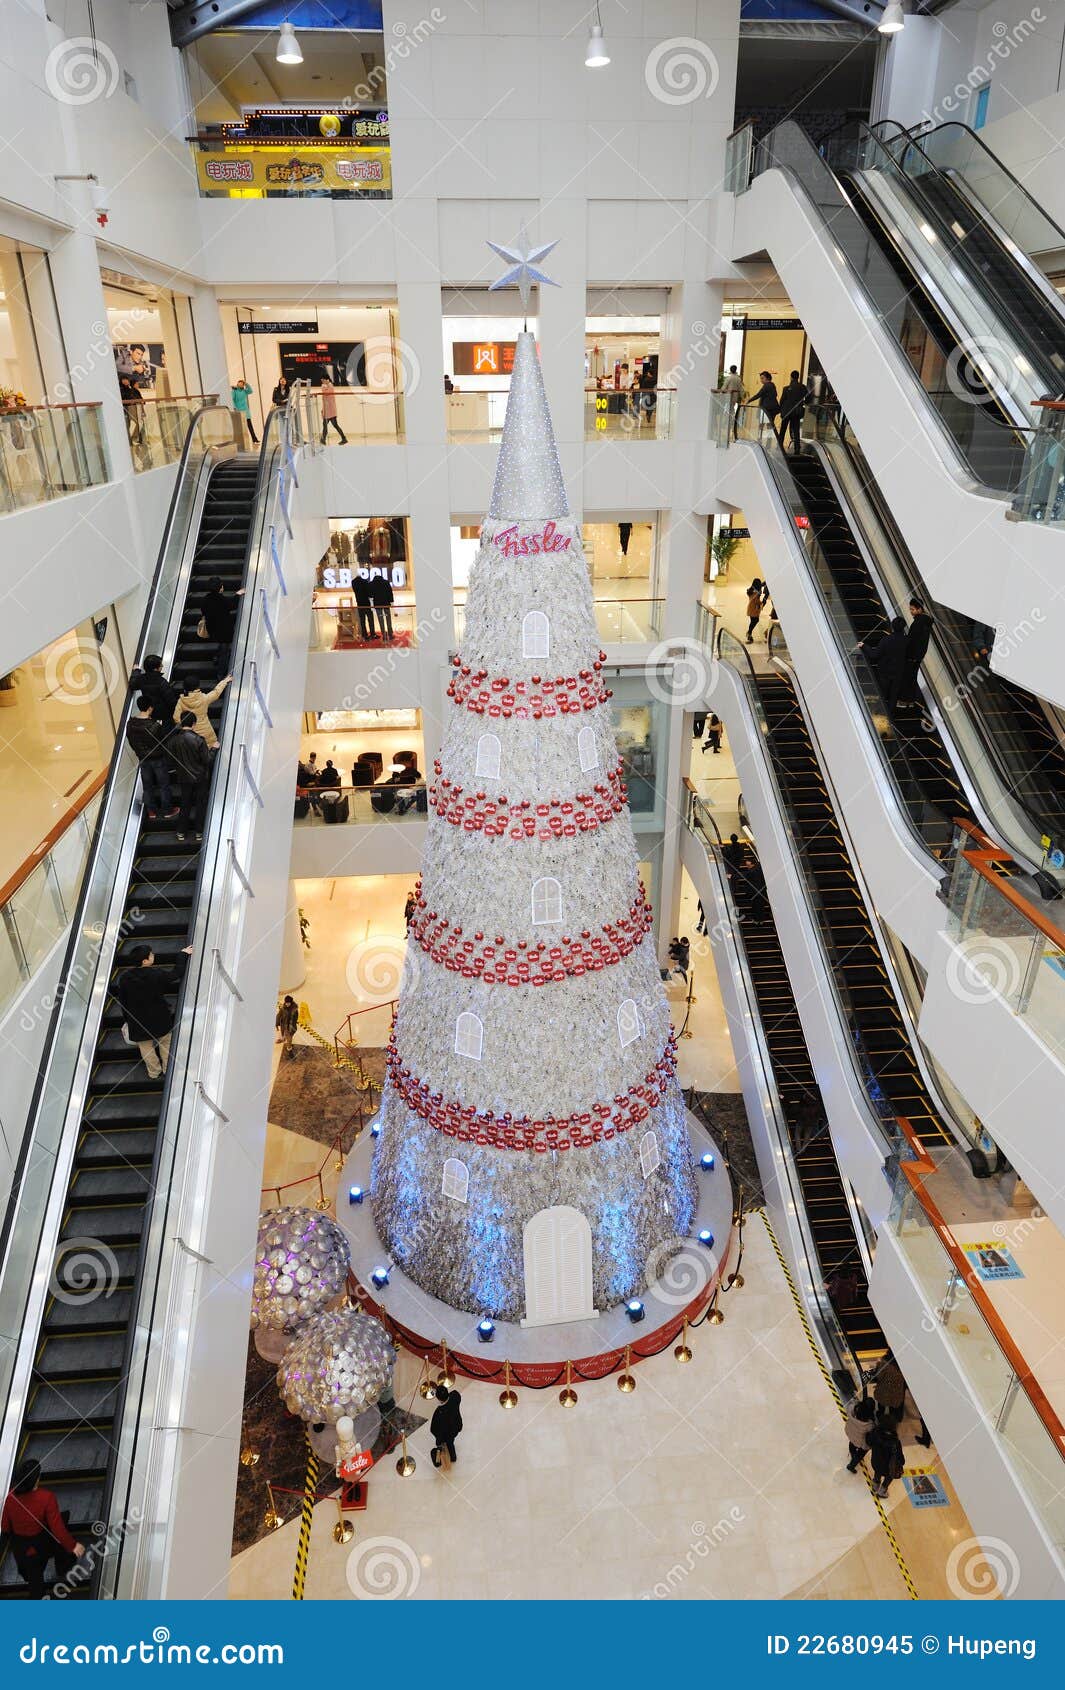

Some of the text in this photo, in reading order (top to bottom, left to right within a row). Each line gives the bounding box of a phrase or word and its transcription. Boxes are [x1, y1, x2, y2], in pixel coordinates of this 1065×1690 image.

[207, 161, 252, 181] 电玩城
[338, 161, 381, 180] 电玩城
